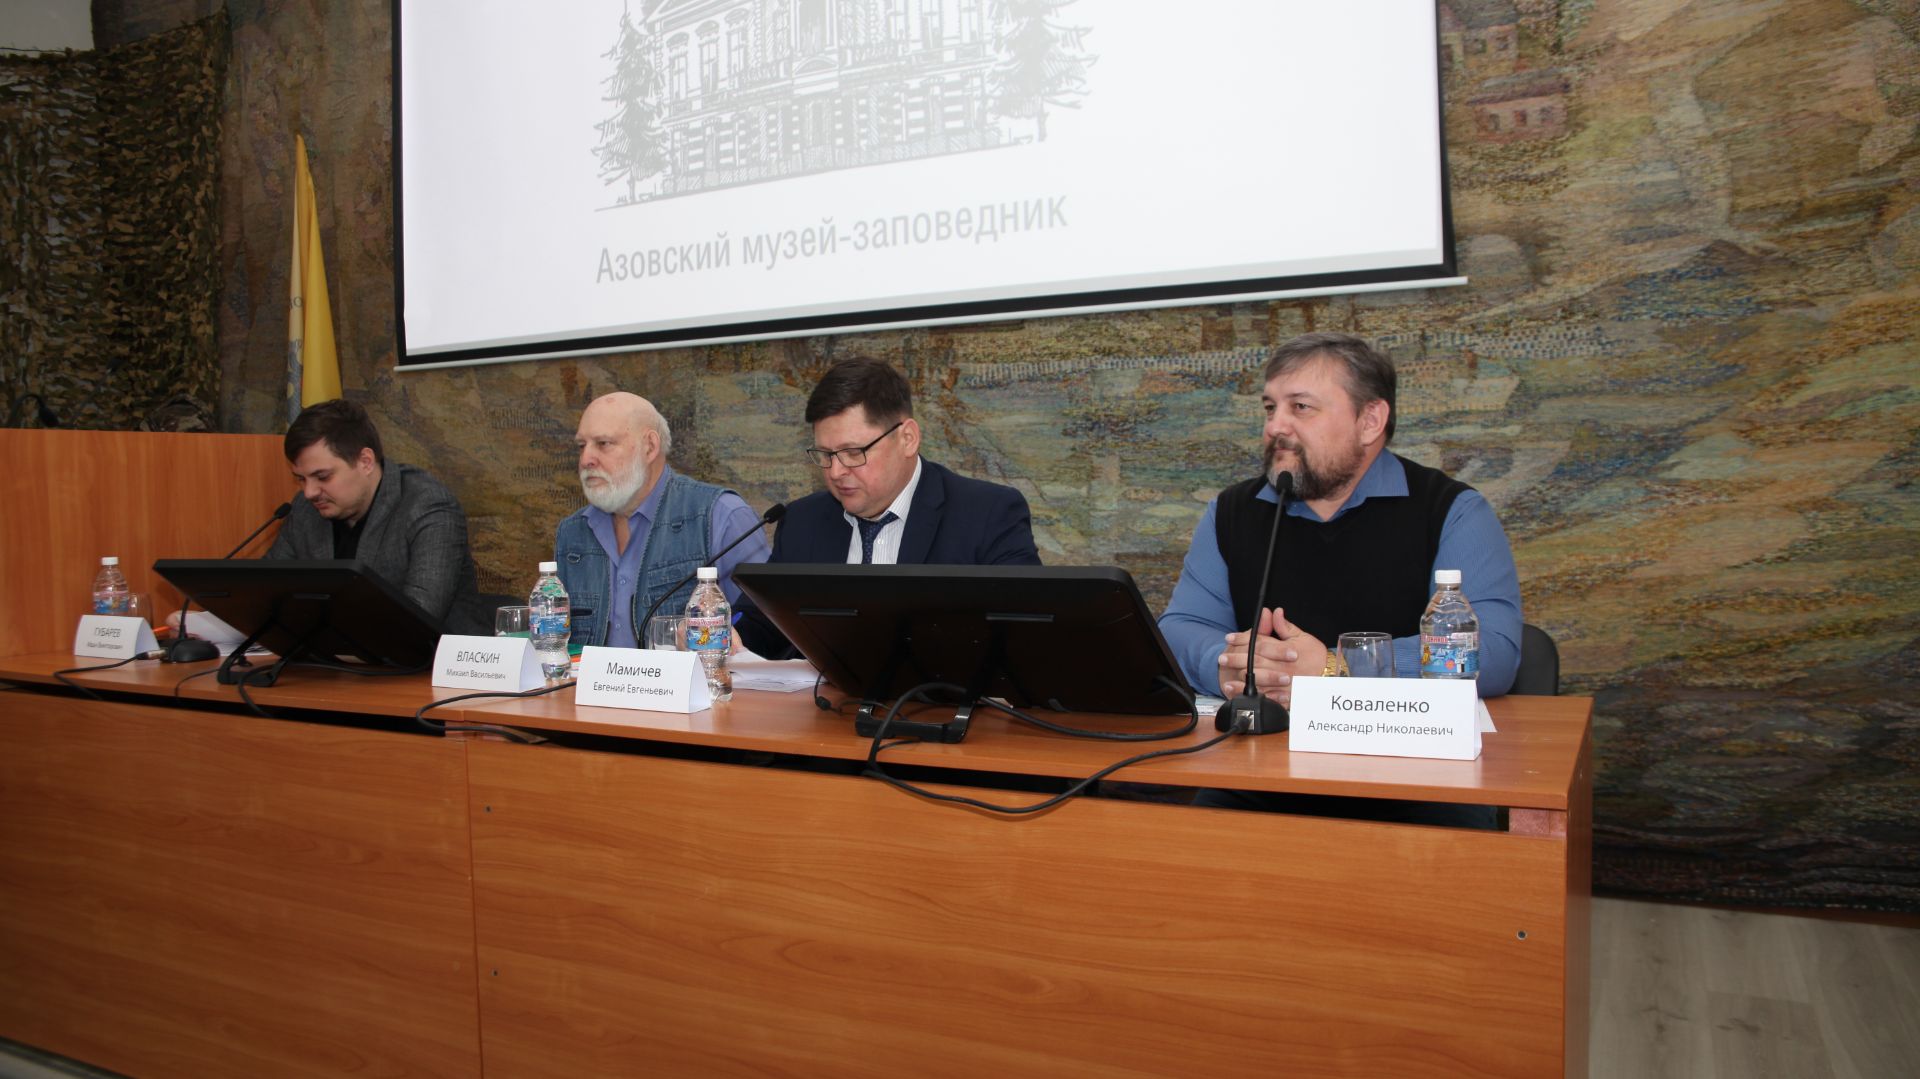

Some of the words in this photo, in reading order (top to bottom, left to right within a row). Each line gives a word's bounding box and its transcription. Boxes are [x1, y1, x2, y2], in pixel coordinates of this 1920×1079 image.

[595, 231, 731, 284] Азовский
[742, 194, 1068, 271] музей-заповедник
[456, 650, 501, 665] ВЛАСКИН
[446, 668, 470, 677] Михаил
[470, 669, 506, 680] Васильевич
[606, 661, 662, 678] Мамичев
[593, 680, 626, 693] Евгений
[627, 683, 674, 696] Евгеньевич
[1331, 695, 1430, 714] Коваленко
[1307, 719, 1373, 736] Александр
[1376, 722, 1454, 736] Николаевич
